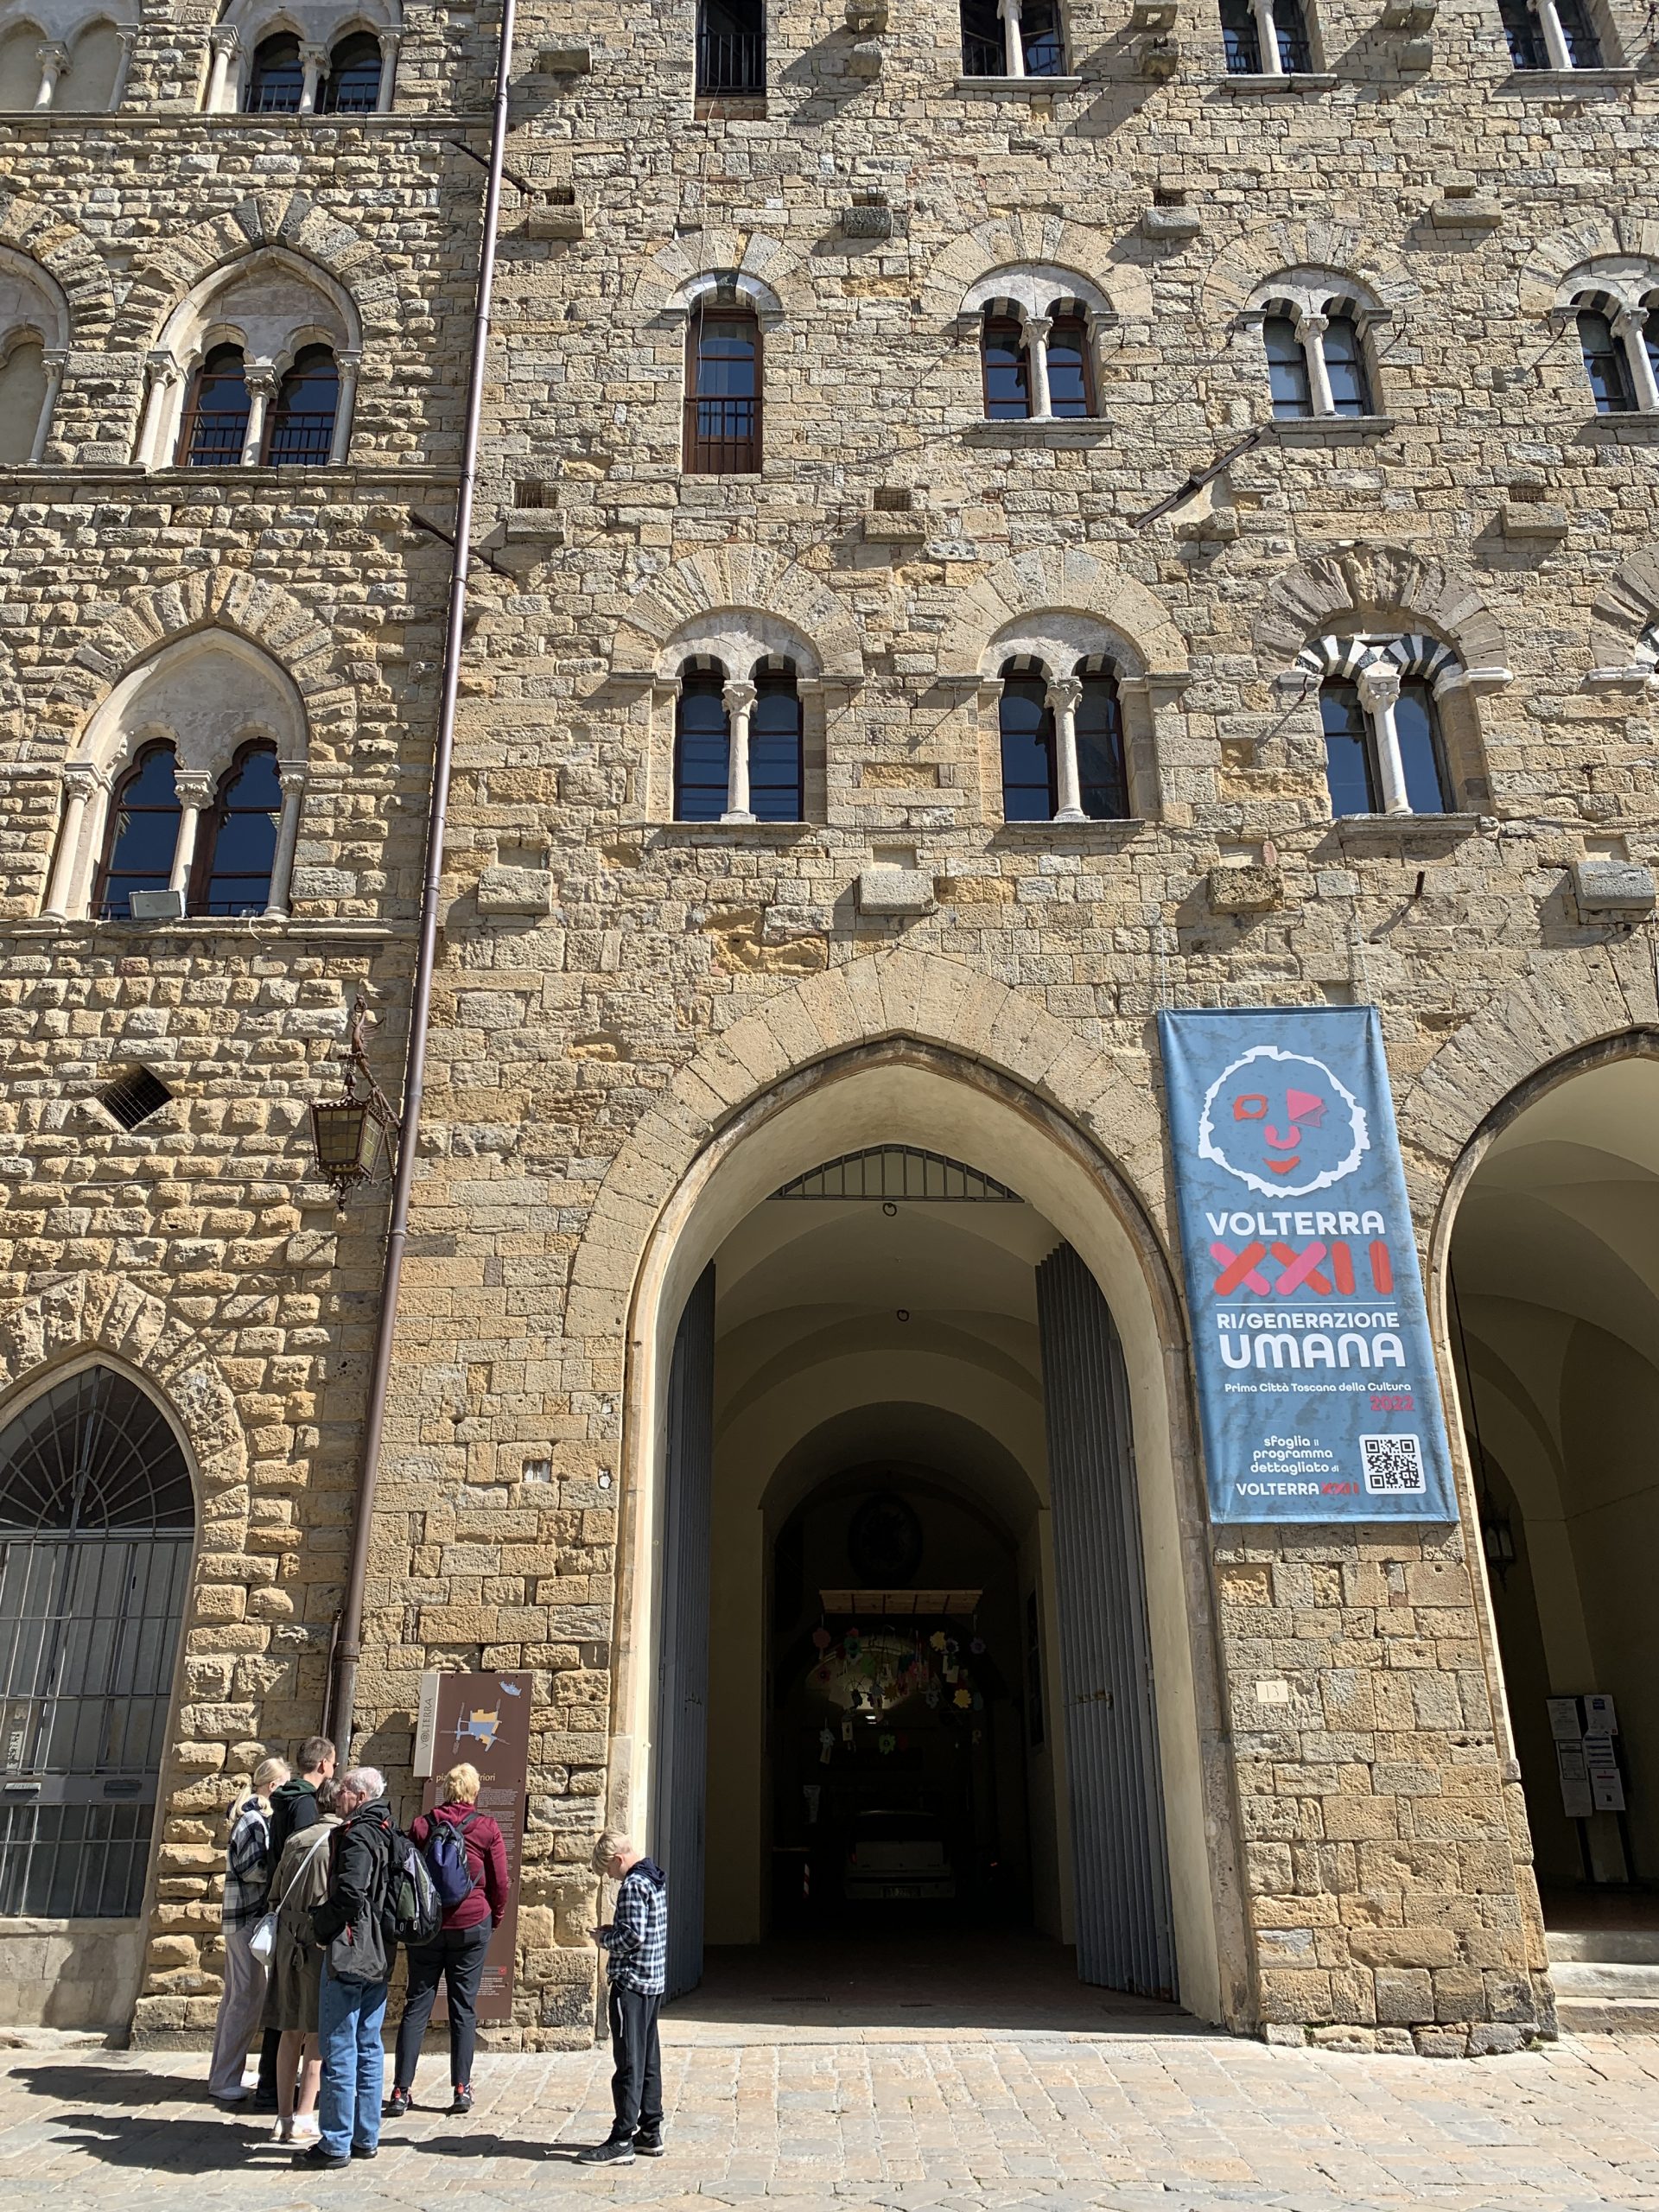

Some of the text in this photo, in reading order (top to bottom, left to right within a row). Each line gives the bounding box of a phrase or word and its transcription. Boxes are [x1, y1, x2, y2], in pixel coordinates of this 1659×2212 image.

[1205, 1211, 1385, 1236] VOLTERRA
[1210, 1240, 1393, 1296] XXII
[1217, 1312, 1400, 1329] RI/GENERAZIONE
[1218, 1332, 1406, 1369] UMANA
[1224, 1382, 1412, 1392] Prima Città Toscana della Cultura
[1370, 1395, 1414, 1411] 2022
[1264, 1435, 1311, 1449] sfoglia
[1253, 1449, 1333, 1461] programma
[1250, 1462, 1330, 1476] dettagliato
[1236, 1483, 1319, 1496] VOLTERRA
[421, 1697, 434, 1750] VOLTERRA
[479, 1772, 496, 1782] riori
